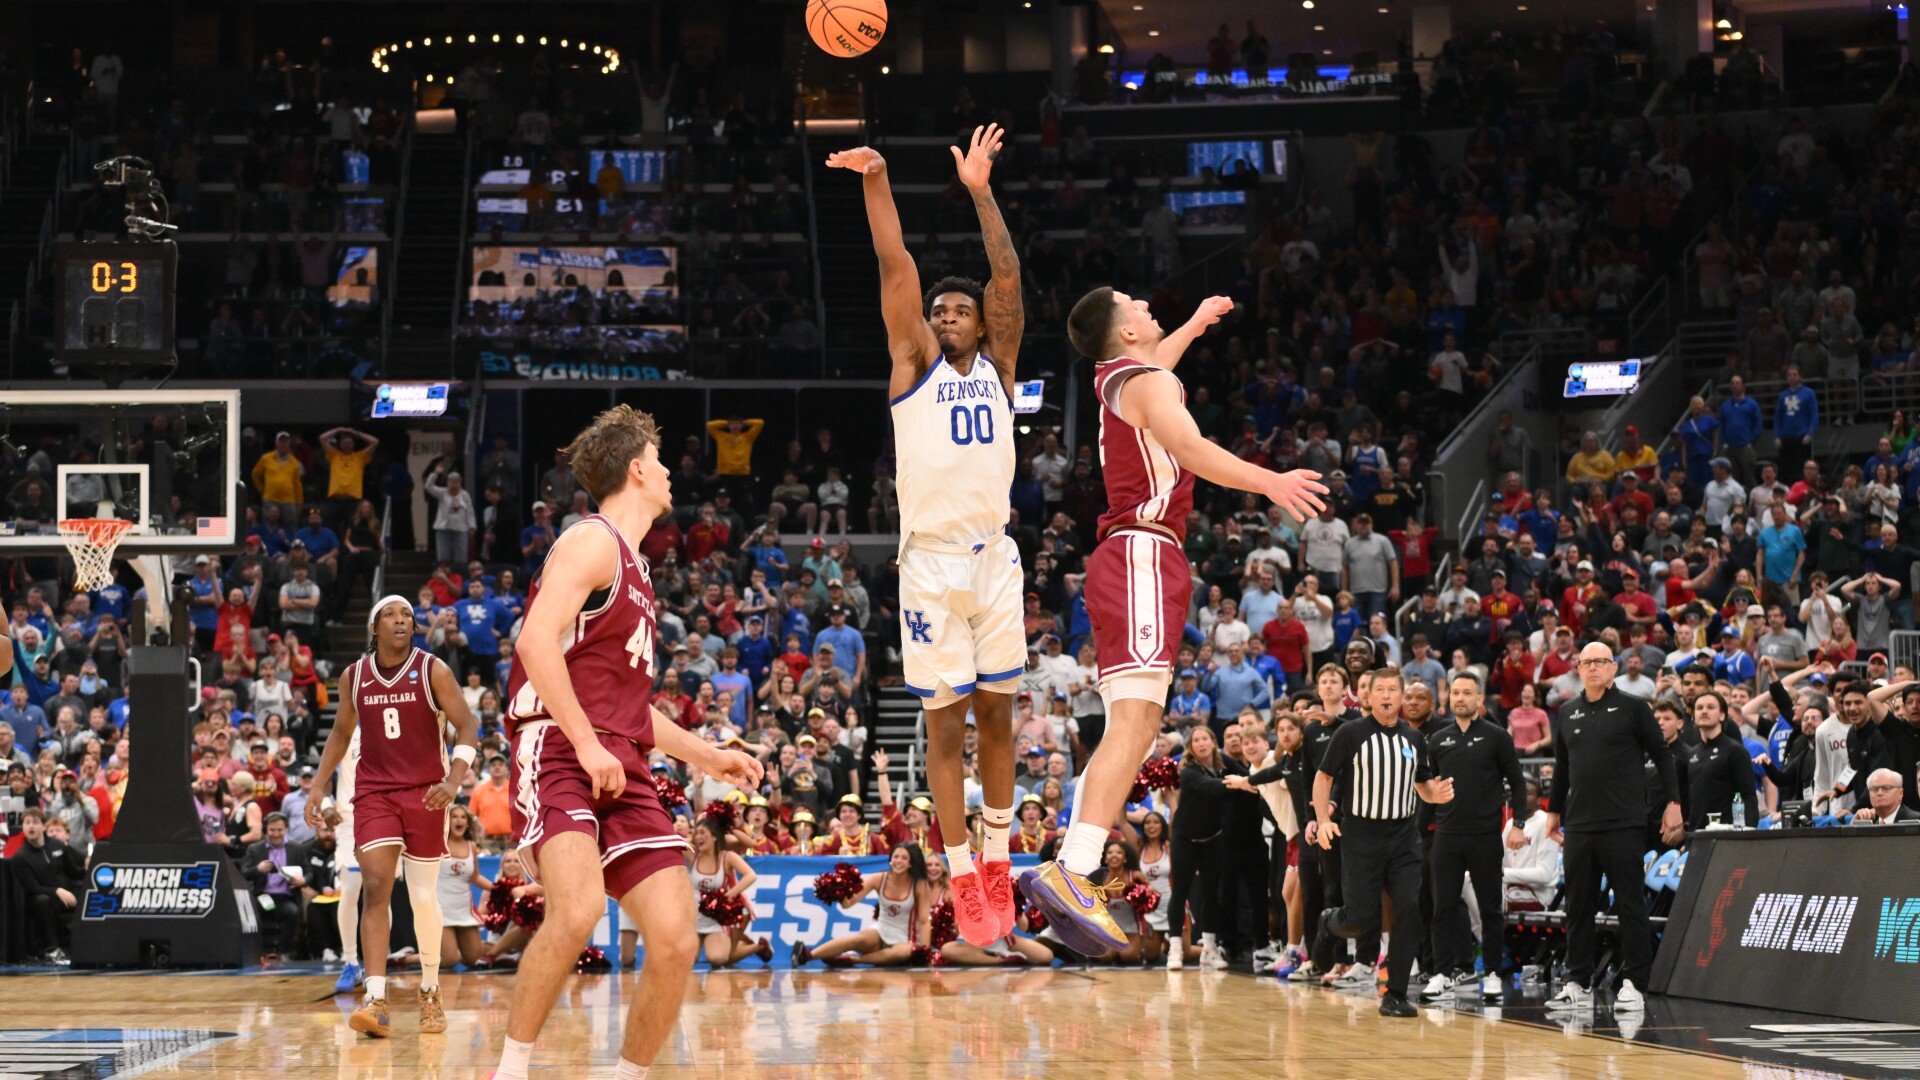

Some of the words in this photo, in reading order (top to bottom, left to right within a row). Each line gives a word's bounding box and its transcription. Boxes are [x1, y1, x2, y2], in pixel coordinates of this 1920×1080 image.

[857, 21, 883, 41] NCAA
[91, 261, 138, 293] 0.3
[951, 404, 994, 445] 00
[903, 608, 933, 645] UK
[625, 616, 654, 677] 44
[363, 694, 389, 705] SANTA
[389, 692, 416, 704] CLARA
[383, 707, 401, 740] 8
[113, 868, 183, 889] MARCH
[121, 888, 213, 909] MADNESS
[1740, 893, 1804, 950] SANTA
[1792, 895, 1859, 954] CLARA
